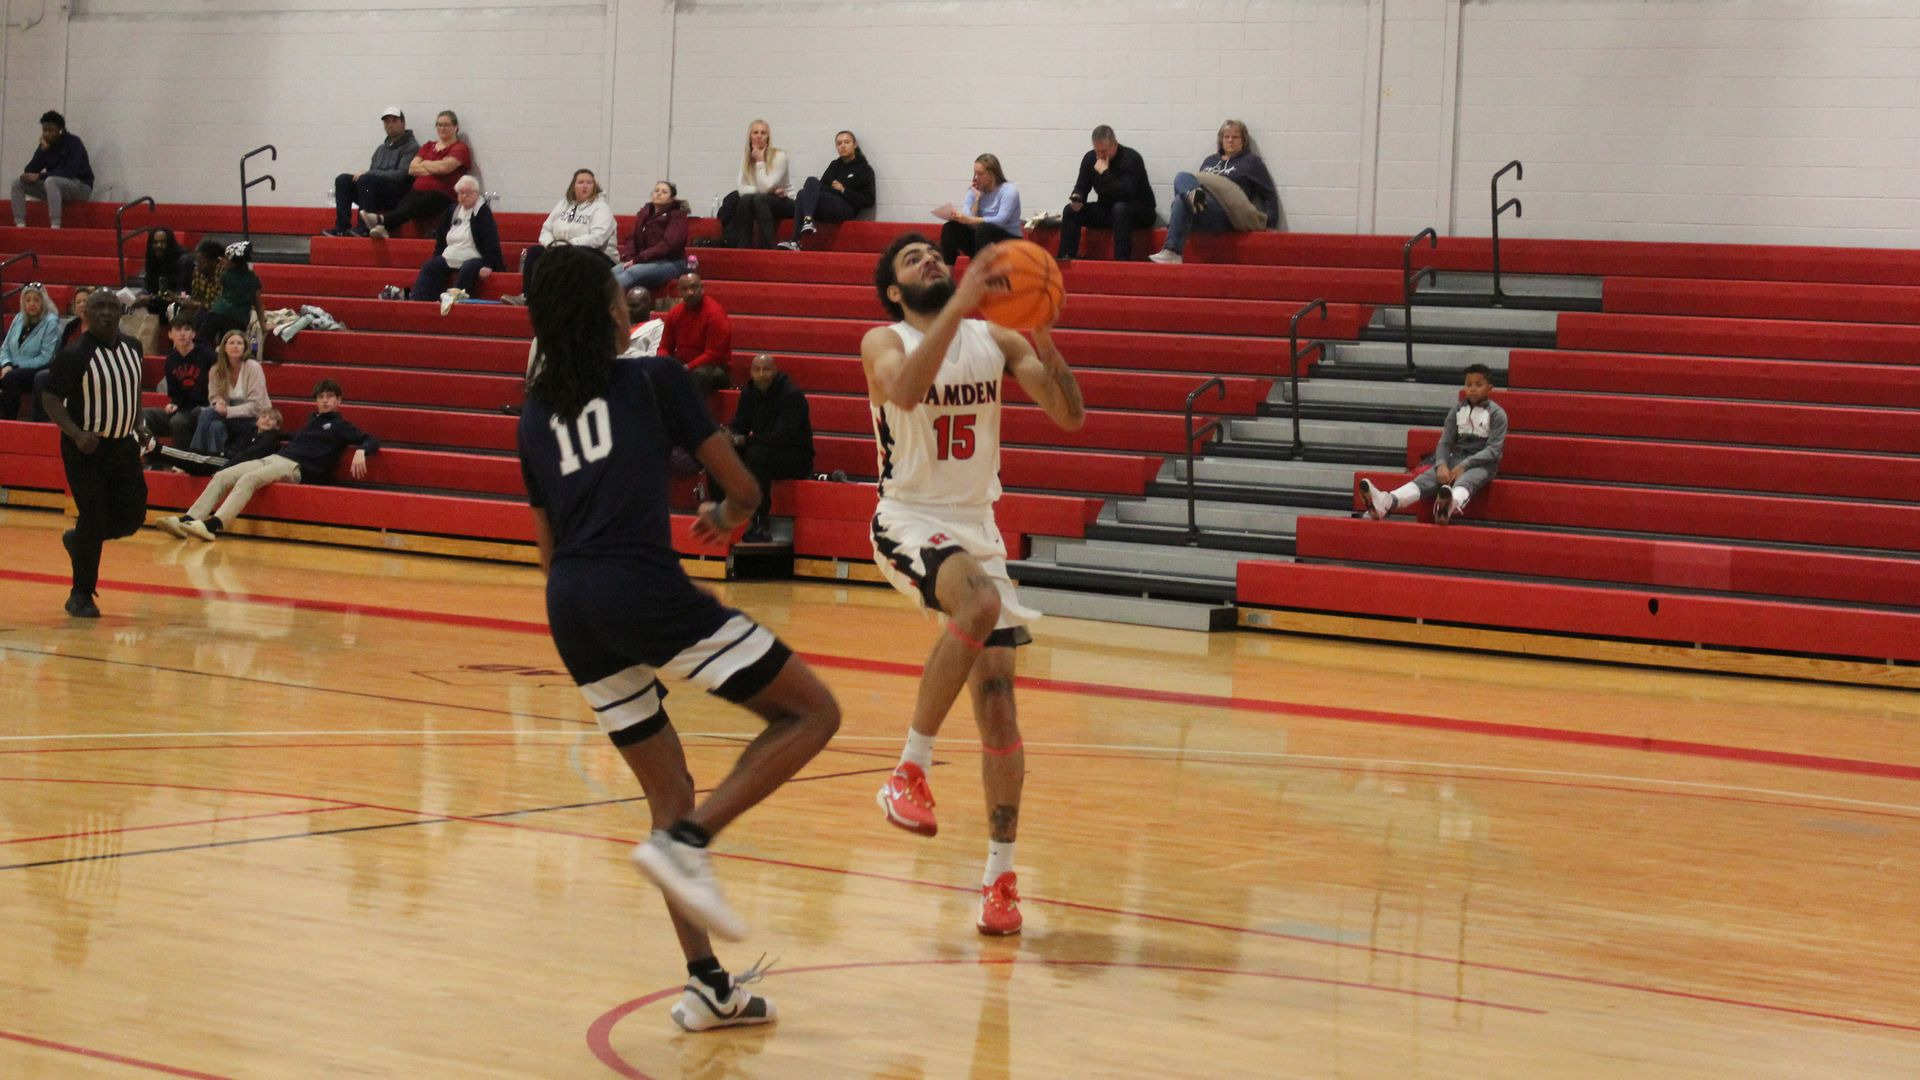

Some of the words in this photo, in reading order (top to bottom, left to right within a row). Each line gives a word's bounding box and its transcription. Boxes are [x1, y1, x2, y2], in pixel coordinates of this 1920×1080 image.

[921, 380, 997, 405] AMDEN
[549, 397, 613, 476] 10
[933, 413, 976, 460] 15
